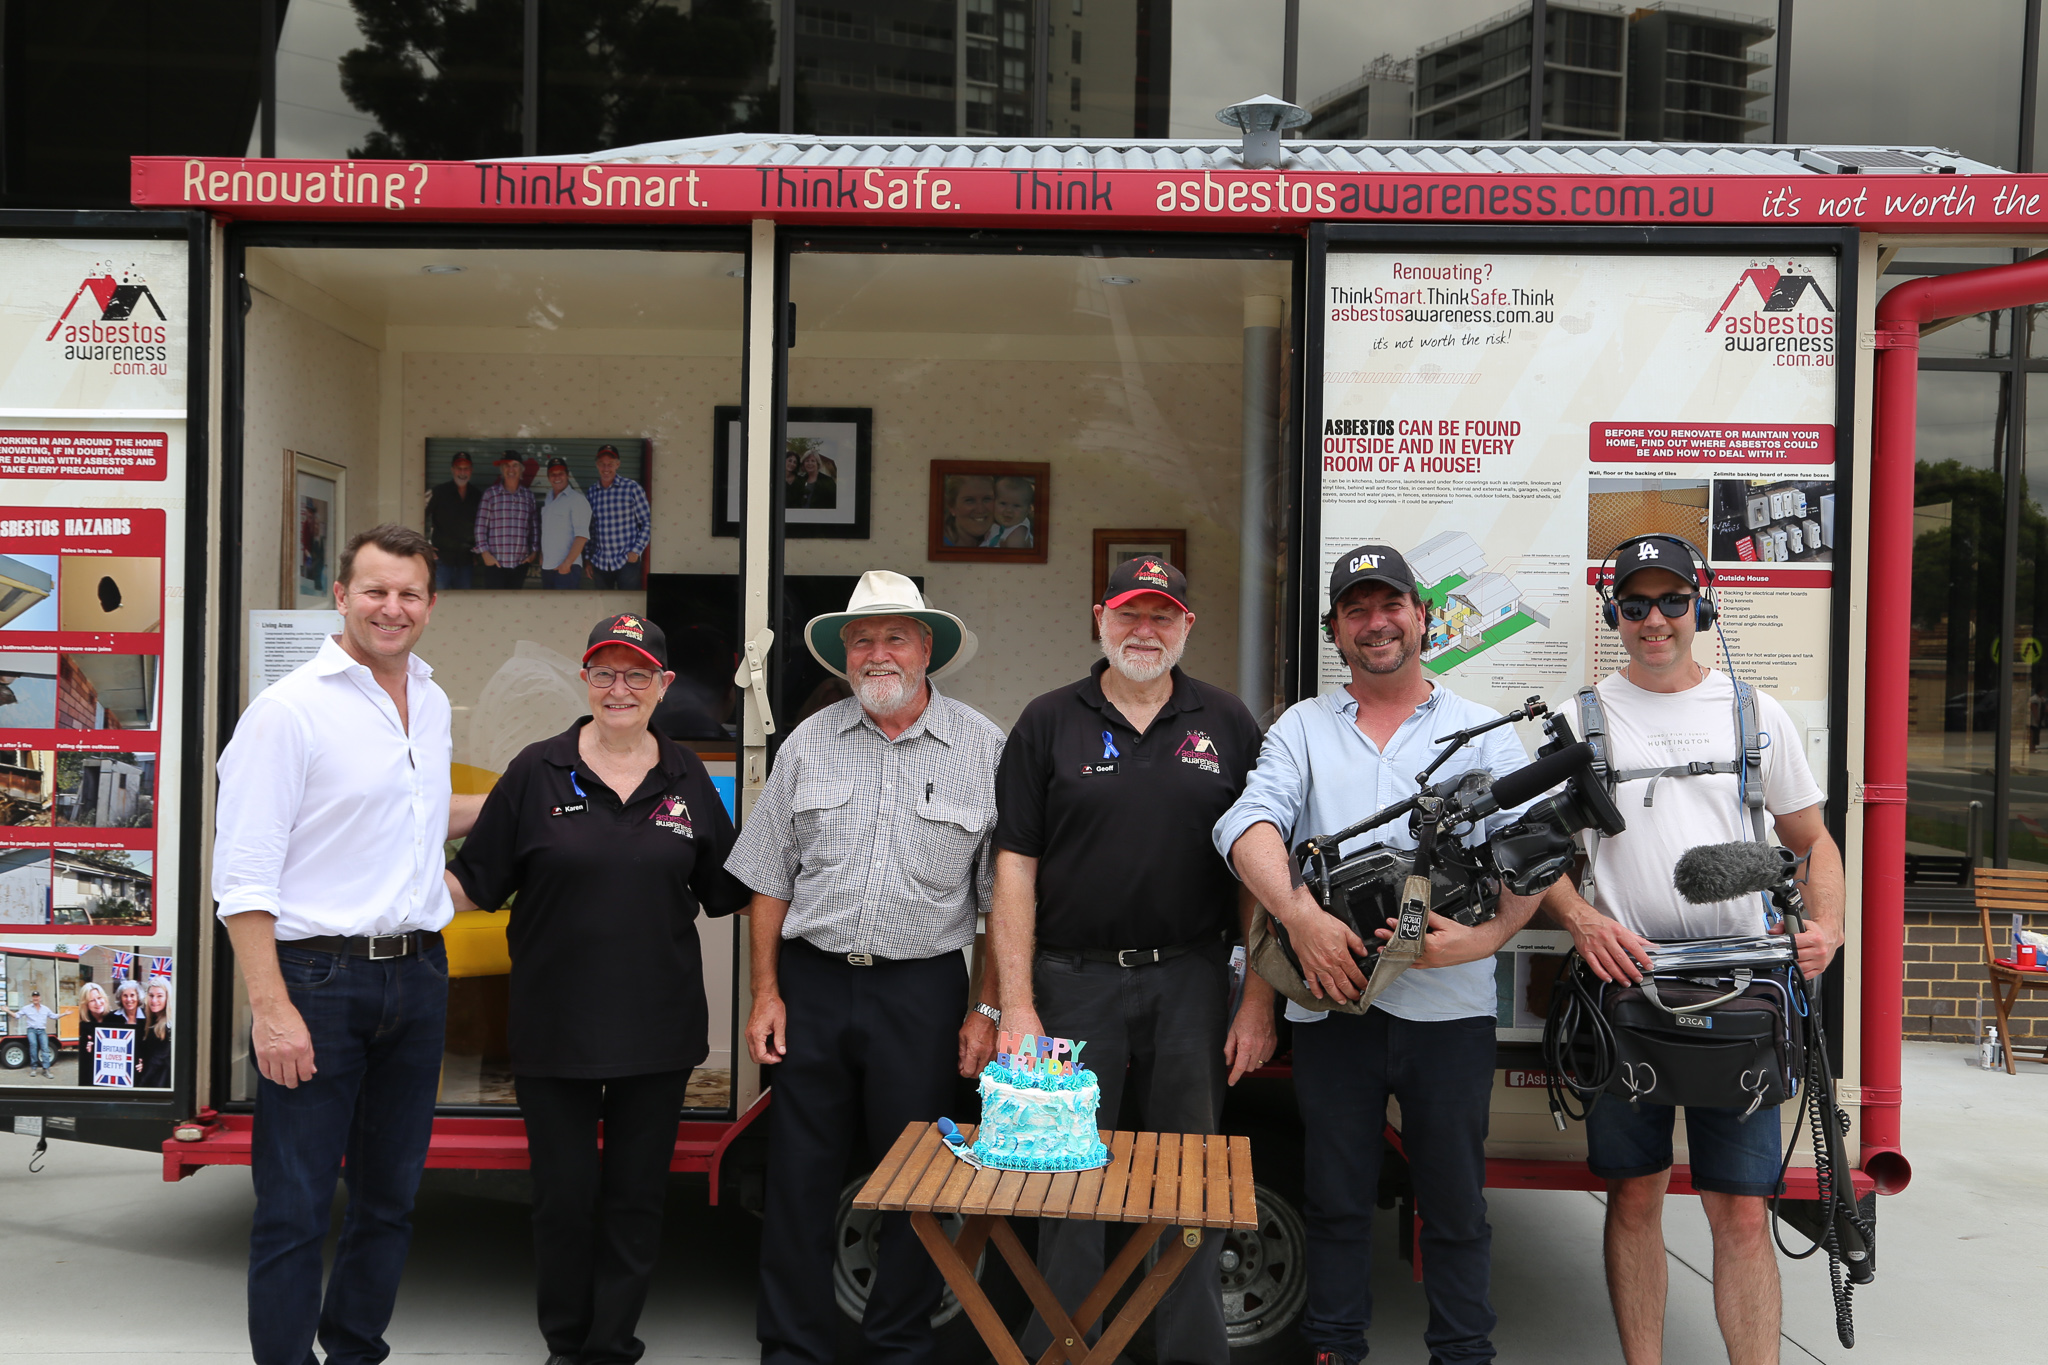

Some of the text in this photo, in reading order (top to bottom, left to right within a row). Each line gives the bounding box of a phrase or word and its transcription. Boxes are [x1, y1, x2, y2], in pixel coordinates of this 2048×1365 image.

[184, 159, 2040, 218] Renovating? ThinkSmart. ThinkSafe. Think asbestosawareness.com.au it's not worth the
[1394, 262, 1492, 284] Renovating?
[1332, 305, 1554, 323] asbestosawareness.com.au
[1725, 310, 1833, 334] asbestos
[65, 320, 166, 343] asbestos
[1374, 329, 1512, 350] it's not worth the risk!
[1725, 336, 1833, 352] awareness
[65, 345, 166, 360] awareness
[1773, 354, 1834, 366] .com.au
[110, 363, 167, 375] .com.au
[1324, 419, 1521, 436] ASBESTOS CAN BE FOUND
[1605, 429, 1644, 437] BEFORE
[1671, 430, 1722, 438] RENOVATE
[1742, 431, 1789, 439] MAINTAIN
[0, 437, 37, 445] ORKING
[73, 438, 113, 446] AROUND
[135, 439, 163, 447] HOME
[1324, 438, 1514, 454] OUTSIDE AND IN EVERY
[1606, 439, 1639, 448] HOME,
[1642, 439, 1664, 447] FIND
[1691, 440, 1726, 448] WHERE
[1783, 441, 1818, 449] COULD
[0, 447, 50, 455] NOVATING,
[77, 448, 111, 456] DOUBT,
[114, 448, 153, 456] ASSUME
[1653, 449, 1673, 457] AND
[1677, 449, 1700, 457] HOW
[1748, 450, 1772, 458] WITH
[1776, 450, 1787, 458] IT.
[136, 458, 156, 466] AND
[1323, 457, 1481, 473] ROOM OF A HOUSE!
[60, 467, 124, 475] PRECAUTION!
[65, 518, 131, 536] HAZARDS
[1638, 542, 1659, 560] LA
[1350, 554, 1380, 573] CAT
[1182, 750, 1218, 762] asbestos
[1096, 764, 1114, 772] Geoff
[1182, 757, 1219, 769] awareness
[565, 804, 583, 812] Karen
[1678, 1016, 1704, 1026] ORCA
[102, 1045, 126, 1053] BRITAIN
[1000, 1031, 1087, 1062] HAPPY
[103, 1061, 124, 1070] BETTY!
[997, 1052, 1085, 1076] BIRTHDAY
